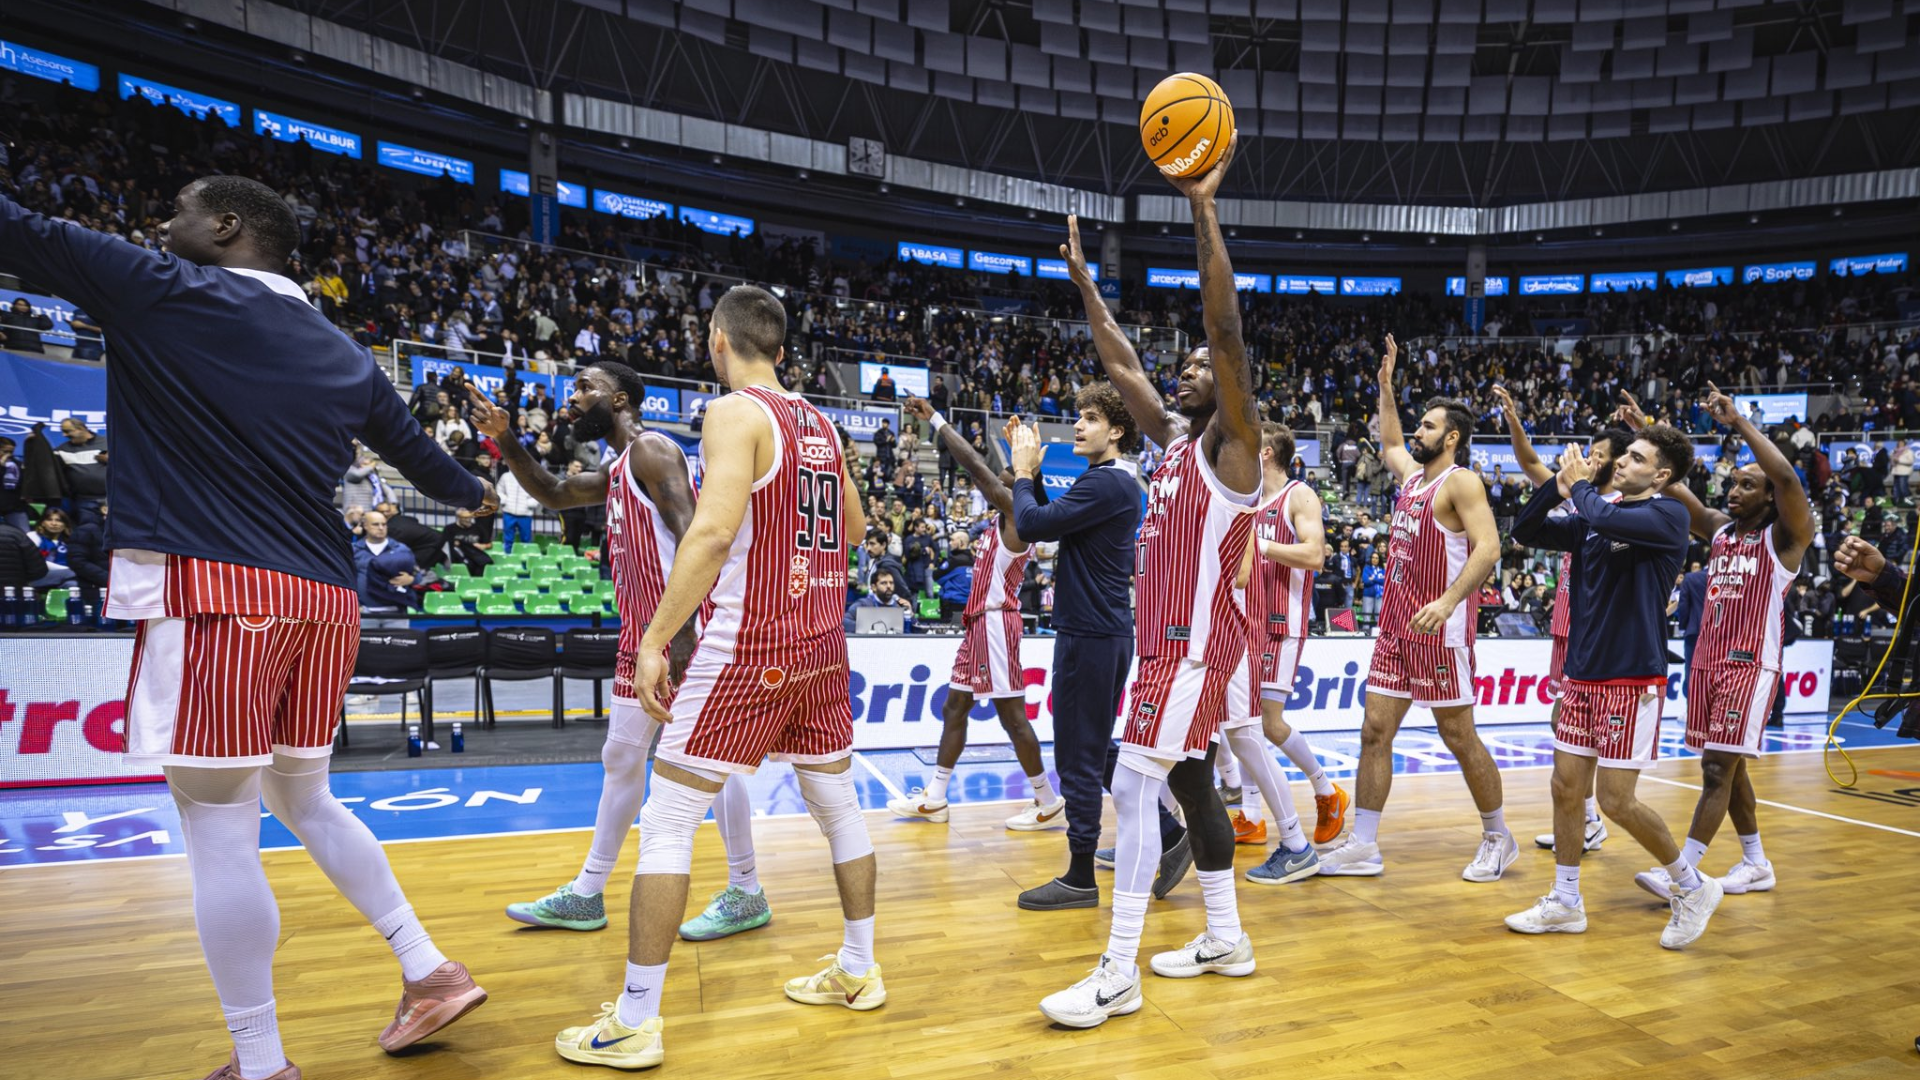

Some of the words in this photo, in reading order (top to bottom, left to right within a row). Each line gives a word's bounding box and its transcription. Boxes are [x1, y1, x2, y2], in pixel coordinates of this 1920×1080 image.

[1150, 126, 1169, 147] acb
[1160, 137, 1210, 175] Wilson
[795, 465, 840, 552] 99
[1708, 555, 1758, 577] UCAM
[1714, 602, 1723, 628] 1
